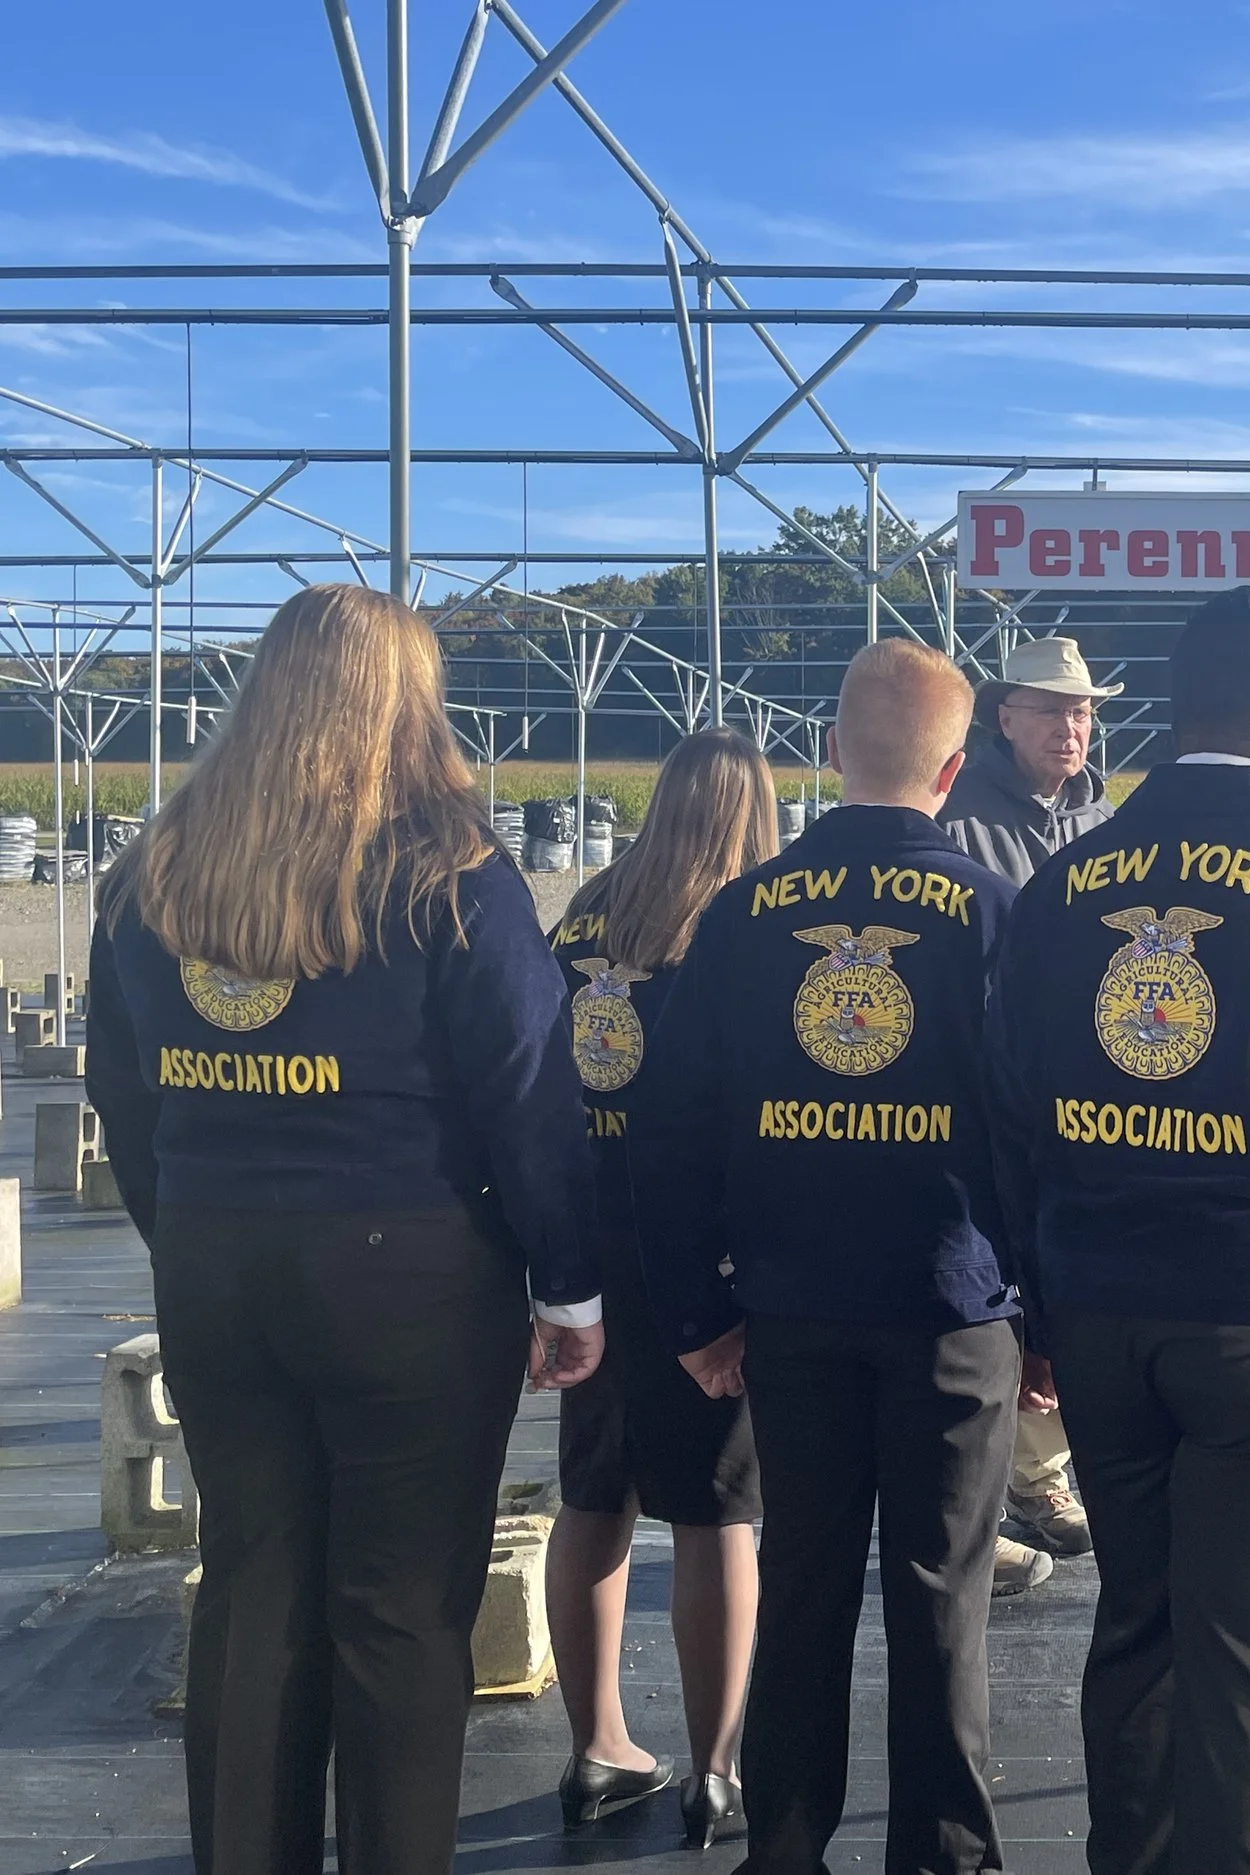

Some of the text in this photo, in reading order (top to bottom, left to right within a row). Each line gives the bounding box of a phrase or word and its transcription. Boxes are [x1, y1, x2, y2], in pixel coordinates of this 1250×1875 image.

[1066, 843, 1159, 906] NEW
[750, 865, 974, 926] NEW YORK
[205, 988, 267, 1012] EDUCATION
[812, 977, 892, 1012] AGRICULTURAL
[832, 991, 875, 1009] FFA
[1114, 965, 1193, 1005] AGRICULTURAL
[1132, 981, 1176, 1001] FFA
[588, 1015, 617, 1033] FFA
[818, 1036, 885, 1059] EDUCATION
[1117, 1032, 1187, 1058] EDUCATION
[159, 1047, 340, 1095] ASSOCIATION
[759, 1100, 952, 1142] ASSOCIATION
[1056, 1098, 1247, 1154] ASSOCIATION
